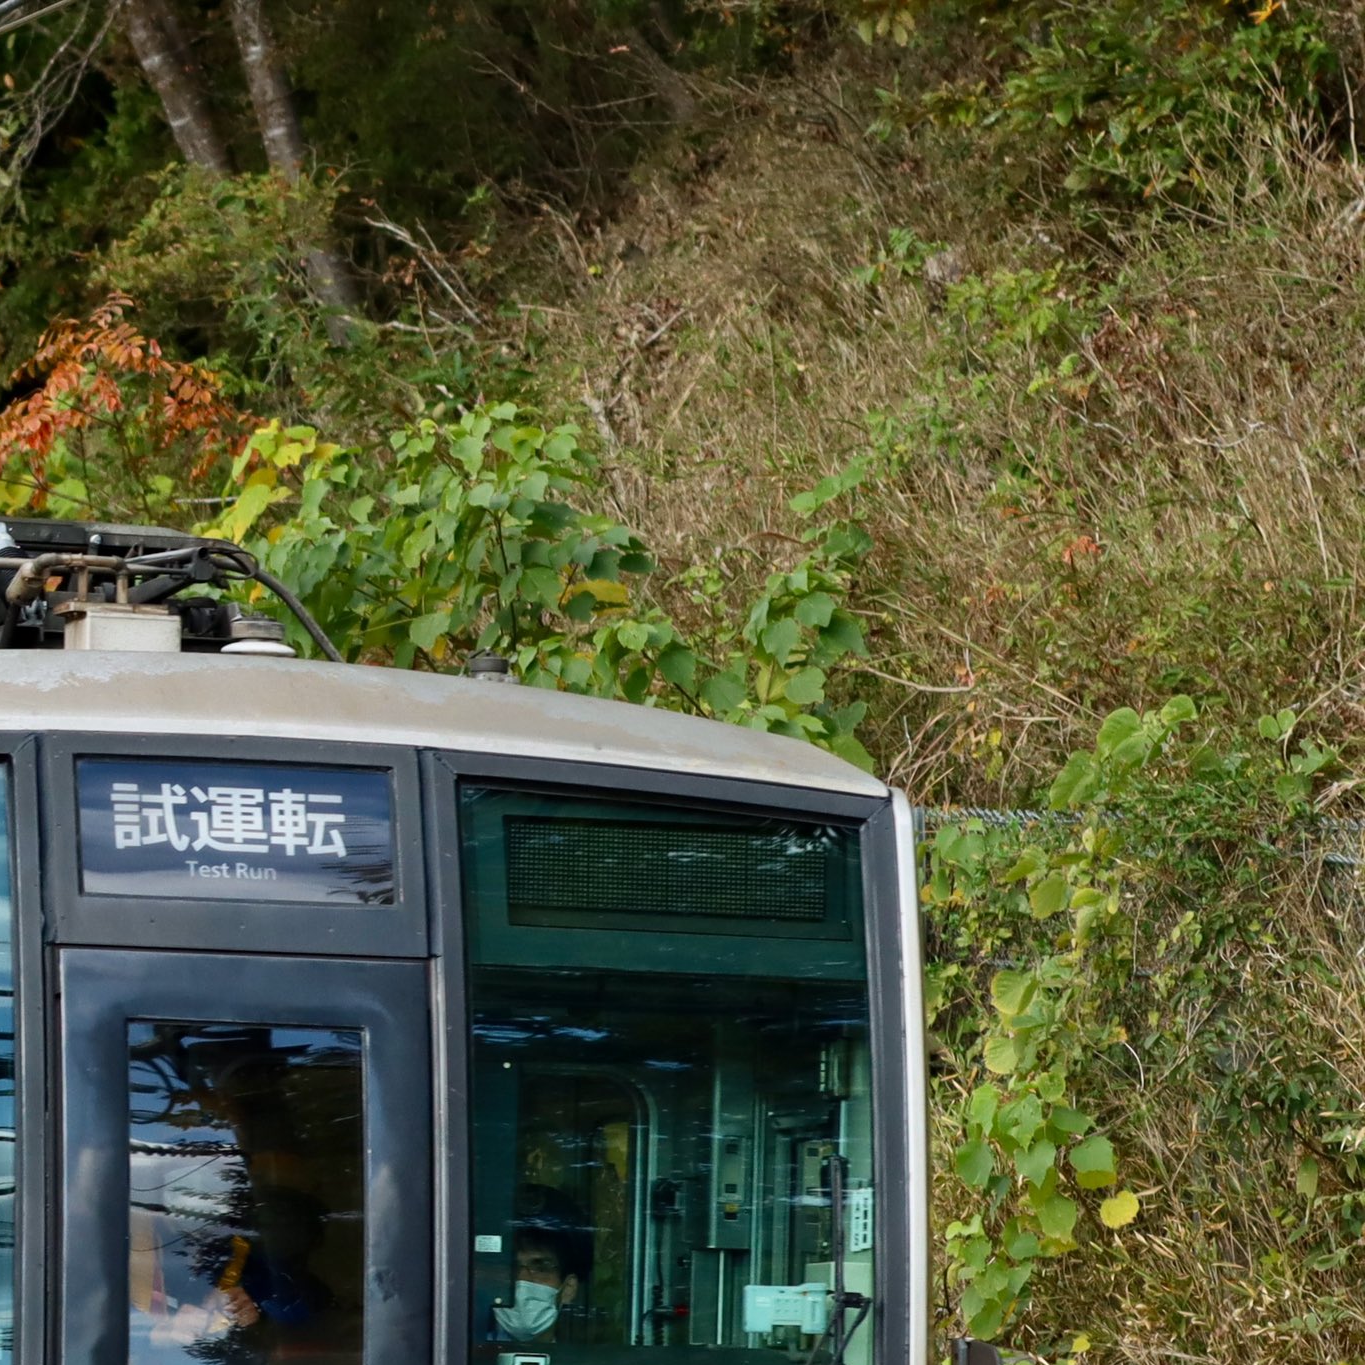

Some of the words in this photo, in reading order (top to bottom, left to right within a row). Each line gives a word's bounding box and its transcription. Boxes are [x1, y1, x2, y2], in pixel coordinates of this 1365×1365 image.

[110, 782, 347, 858] 試運転
[185, 860, 230, 879] Test
[235, 861, 277, 881] Run
